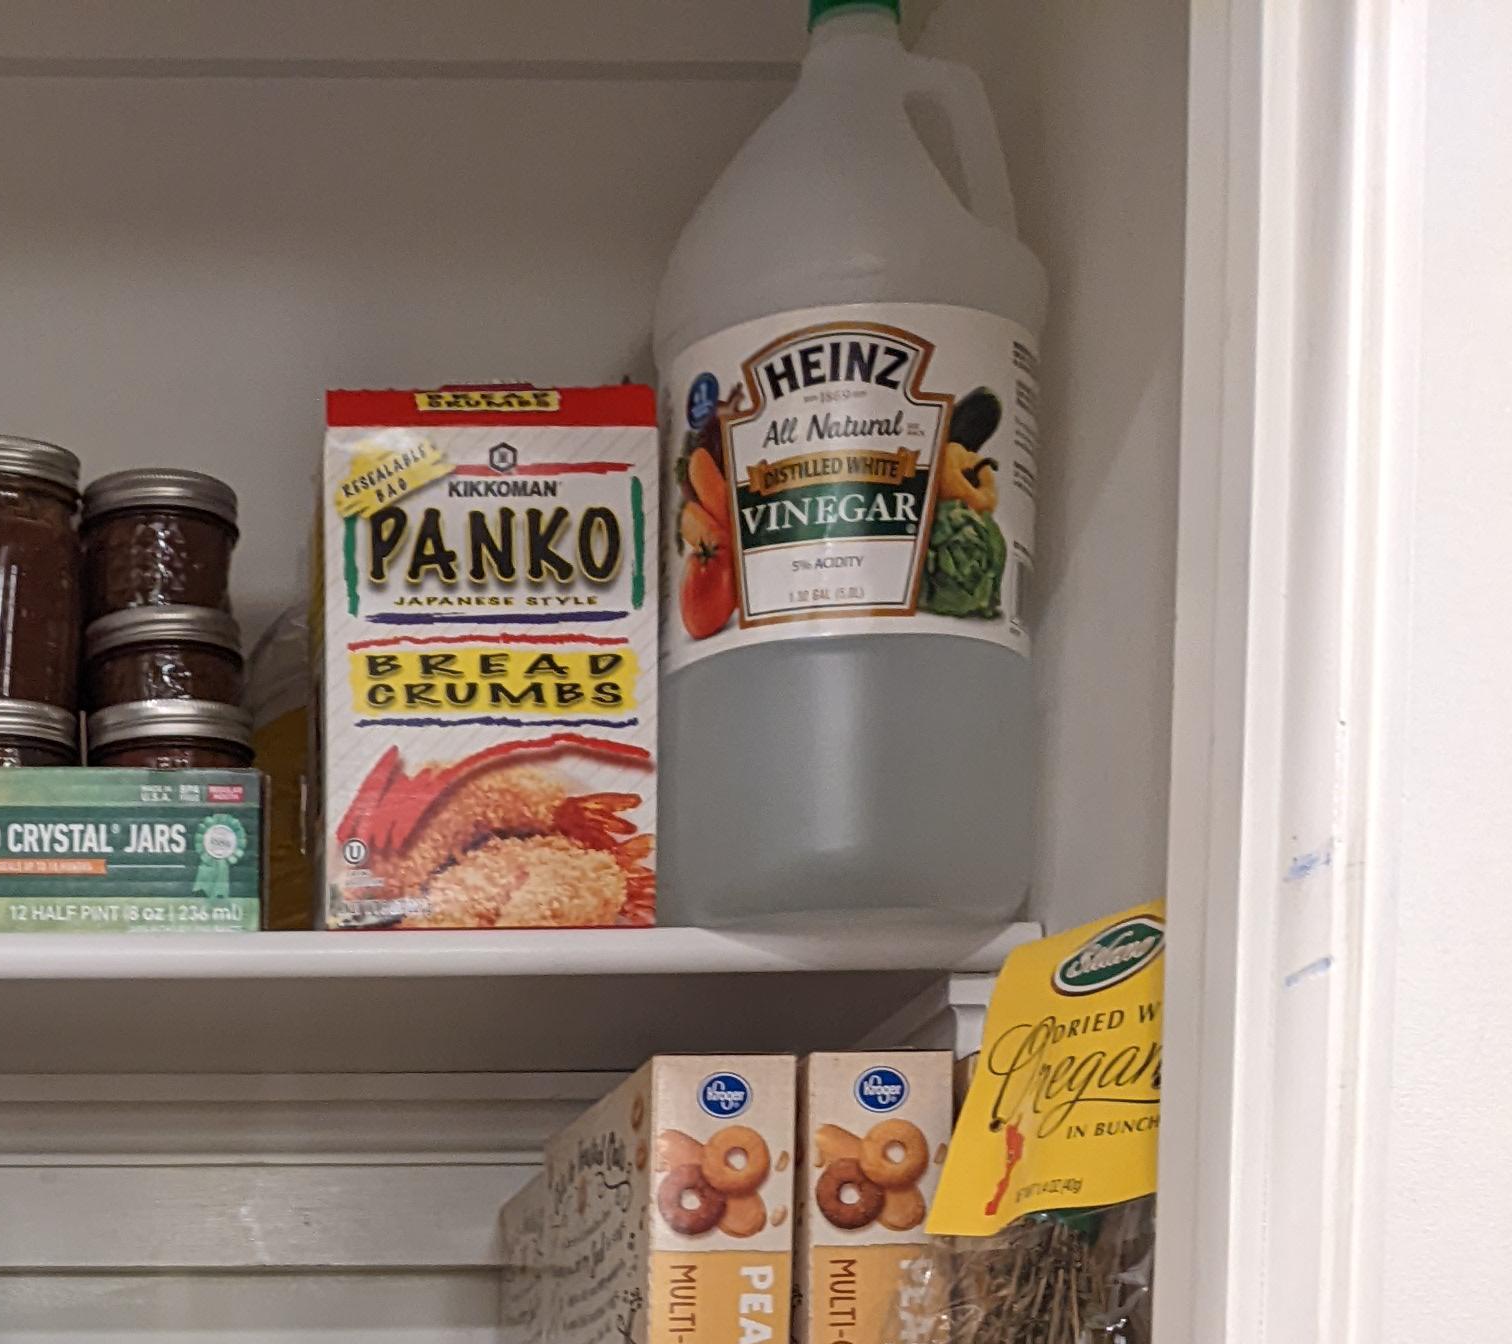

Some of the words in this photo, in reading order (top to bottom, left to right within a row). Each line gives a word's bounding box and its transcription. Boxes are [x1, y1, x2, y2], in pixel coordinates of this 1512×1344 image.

[764, 341, 910, 400] HEINZ
[763, 416, 798, 448] All
[807, 411, 904, 442] Natural
[764, 457, 842, 489] DISTILLED
[847, 456, 901, 479] WHITE
[375, 478, 408, 502] BAG
[448, 480, 558, 498] KIKKOMAN
[741, 491, 920, 535] VINEGAR
[368, 507, 623, 583] PANKO
[815, 556, 865, 571] ACIDITY
[393, 595, 515, 607] JAPANESE
[526, 595, 599, 606] STYLE
[366, 653, 624, 677] BREAD
[366, 682, 624, 707] CRUMBS
[124, 823, 187, 854] JARS
[10, 905, 27, 921] 12
[31, 905, 76, 921] HALF
[80, 905, 119, 921] PINT
[142, 908, 165, 921] oz
[1053, 1009, 1125, 1045] DRIED
[707, 1083, 746, 1108] Kroger
[862, 1077, 903, 1104] Kroger
[1066, 1124, 1085, 1139] IN
[1093, 1114, 1160, 1137] BUNCH
